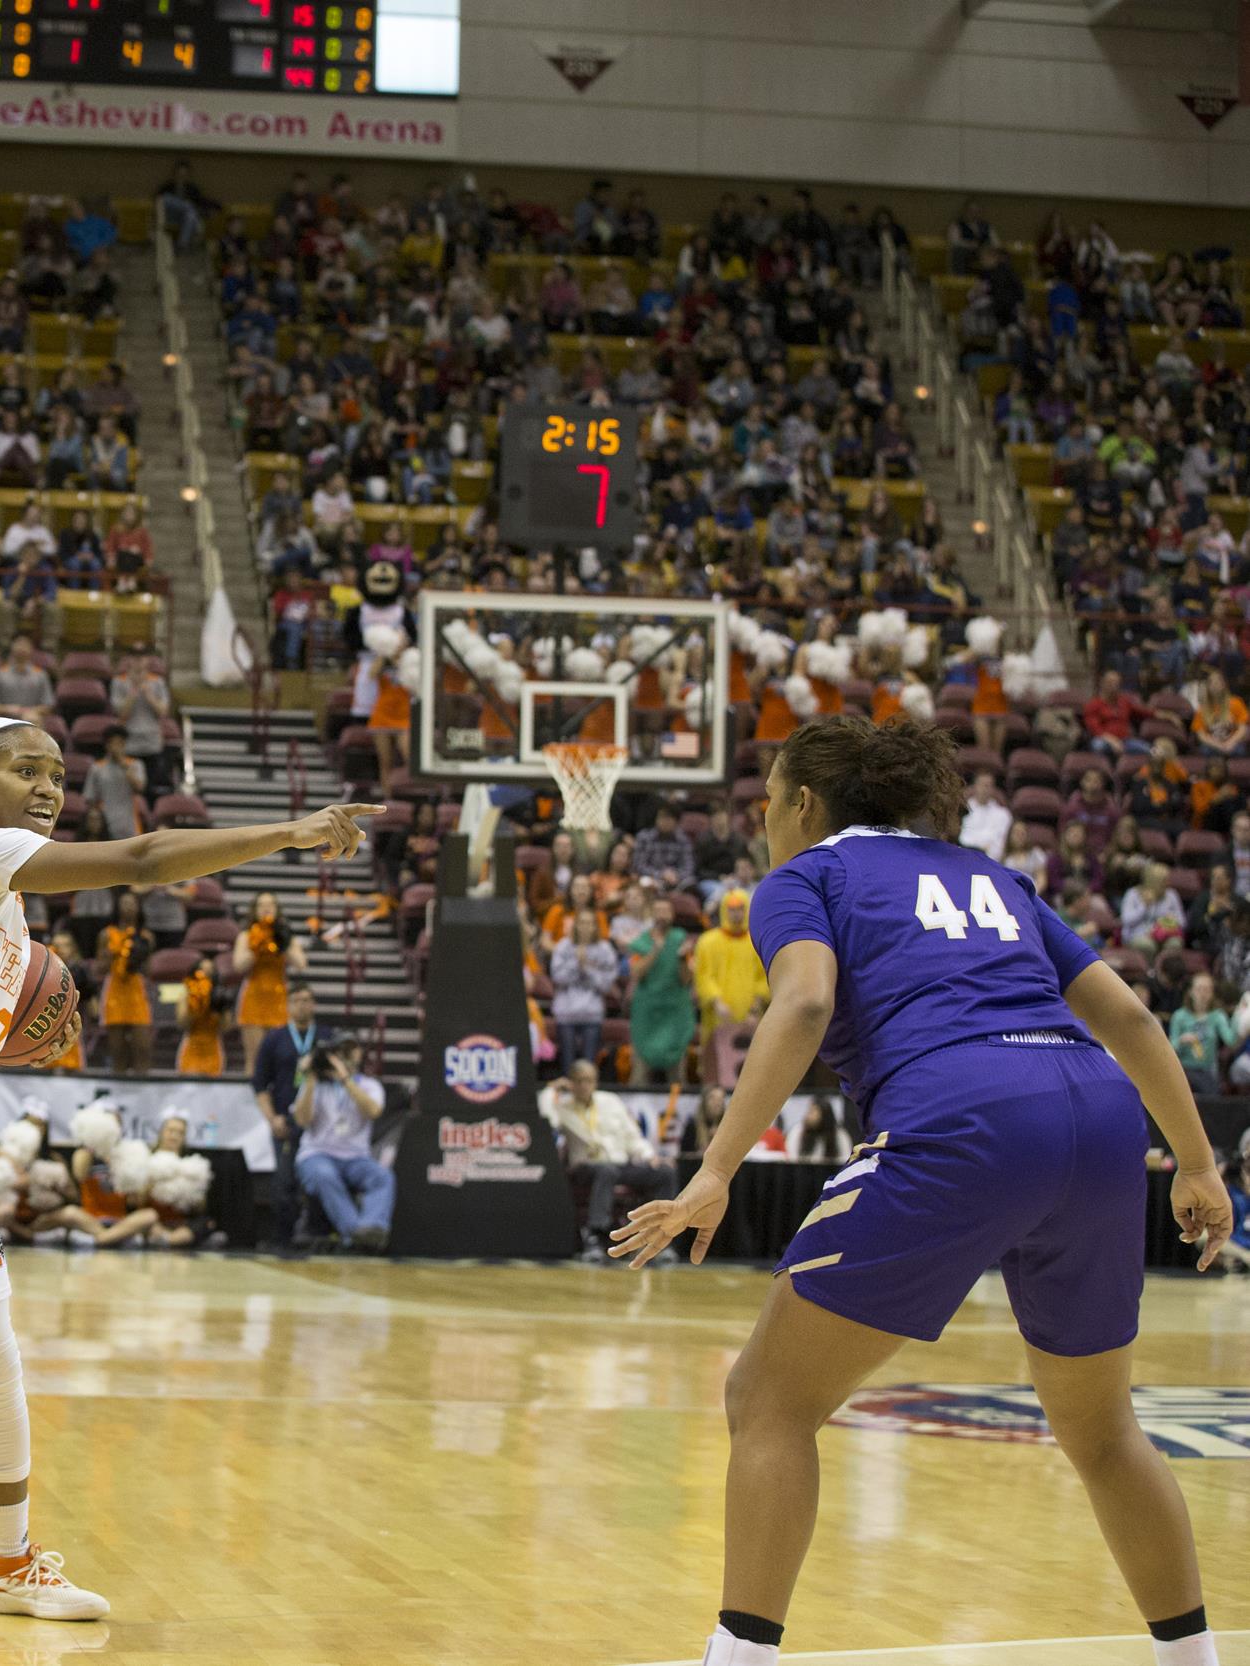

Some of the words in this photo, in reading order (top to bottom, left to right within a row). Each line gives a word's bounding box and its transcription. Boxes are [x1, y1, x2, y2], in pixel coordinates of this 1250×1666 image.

[122, 40, 143, 67] 4
[174, 42, 195, 70] 4
[327, 111, 444, 144] Arena
[542, 415, 620, 455] 2:15
[576, 464, 610, 528] 7
[914, 874, 1021, 941] 44
[22, 965, 71, 1041] Wilson
[445, 1046, 518, 1087] SOCON
